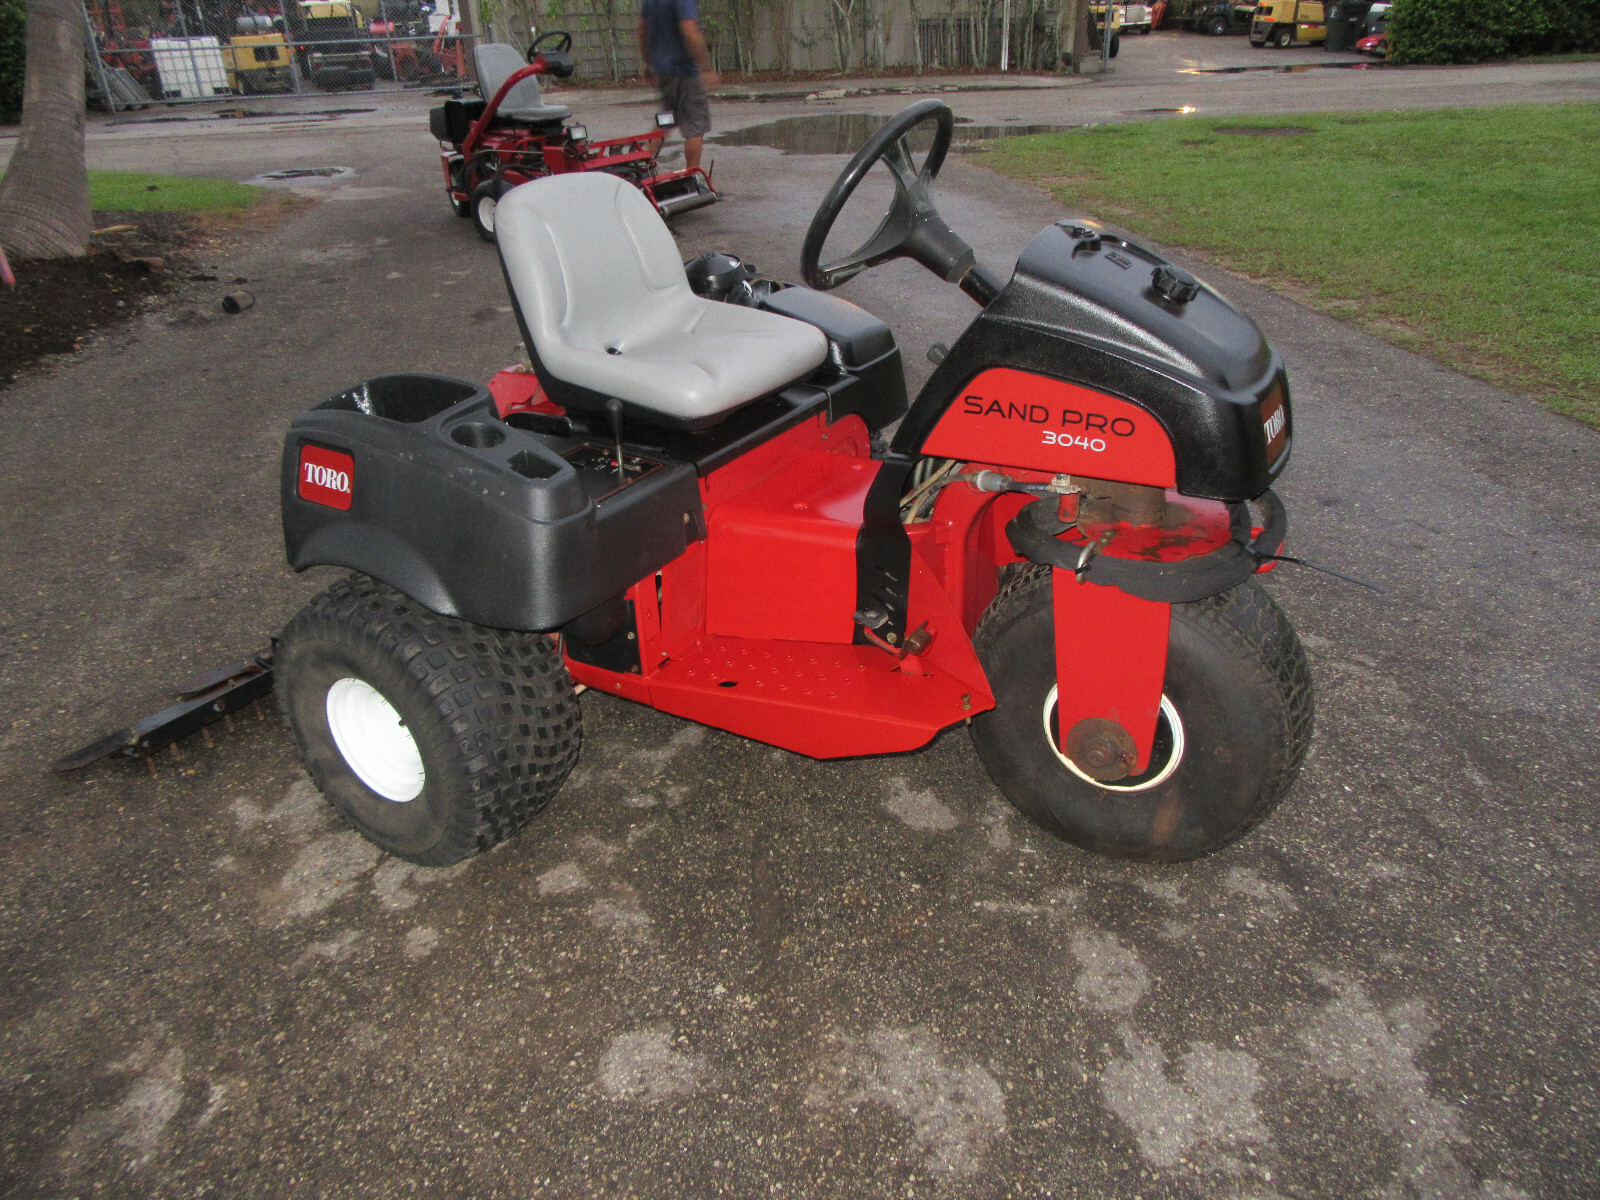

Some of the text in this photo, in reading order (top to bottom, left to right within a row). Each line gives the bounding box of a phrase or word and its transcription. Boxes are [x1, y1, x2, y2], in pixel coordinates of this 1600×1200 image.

[963, 395, 1136, 438] SAND PRO
[1263, 404, 1285, 445] TORO
[1041, 430, 1107, 453] 3040
[304, 462, 350, 493] TORO
